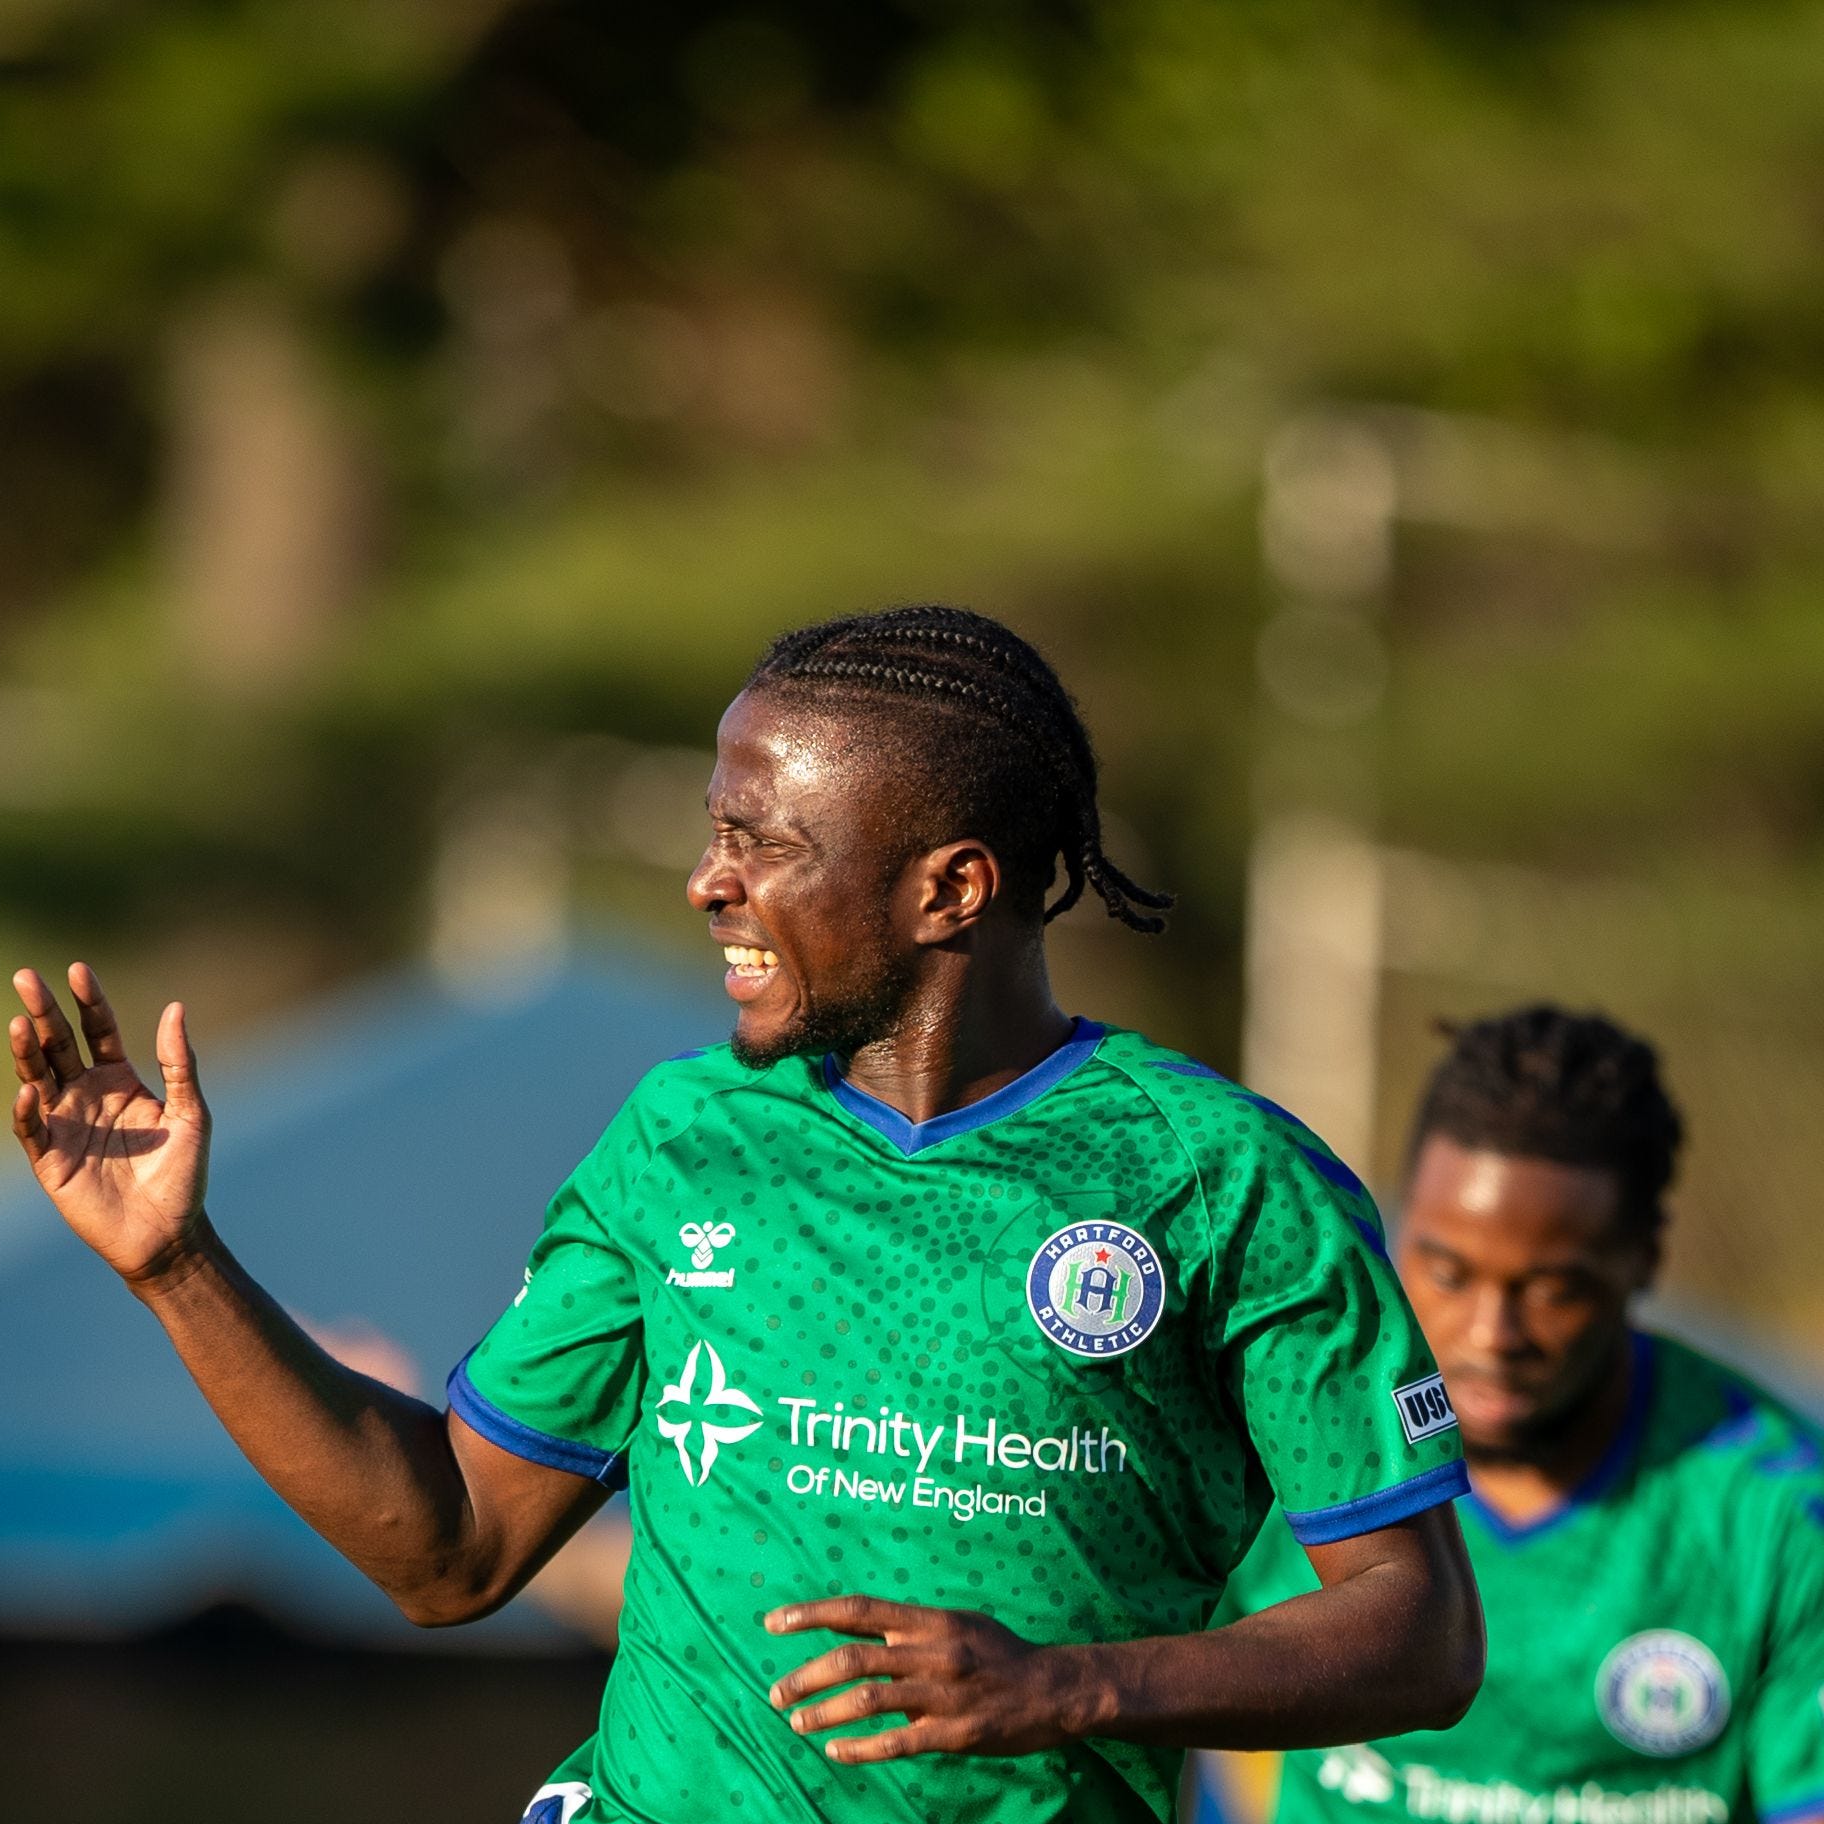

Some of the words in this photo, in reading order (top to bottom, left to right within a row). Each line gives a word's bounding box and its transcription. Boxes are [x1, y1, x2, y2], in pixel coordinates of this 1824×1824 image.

[1045, 1226, 1156, 1275] HARTFORD
[1038, 1306, 1143, 1351] ATHLETIC
[777, 1396, 945, 1473] Trinity
[954, 1414, 1127, 1474] Health
[786, 1464, 830, 1495] Of
[833, 1468, 907, 1504] New
[912, 1477, 1046, 1522] England
